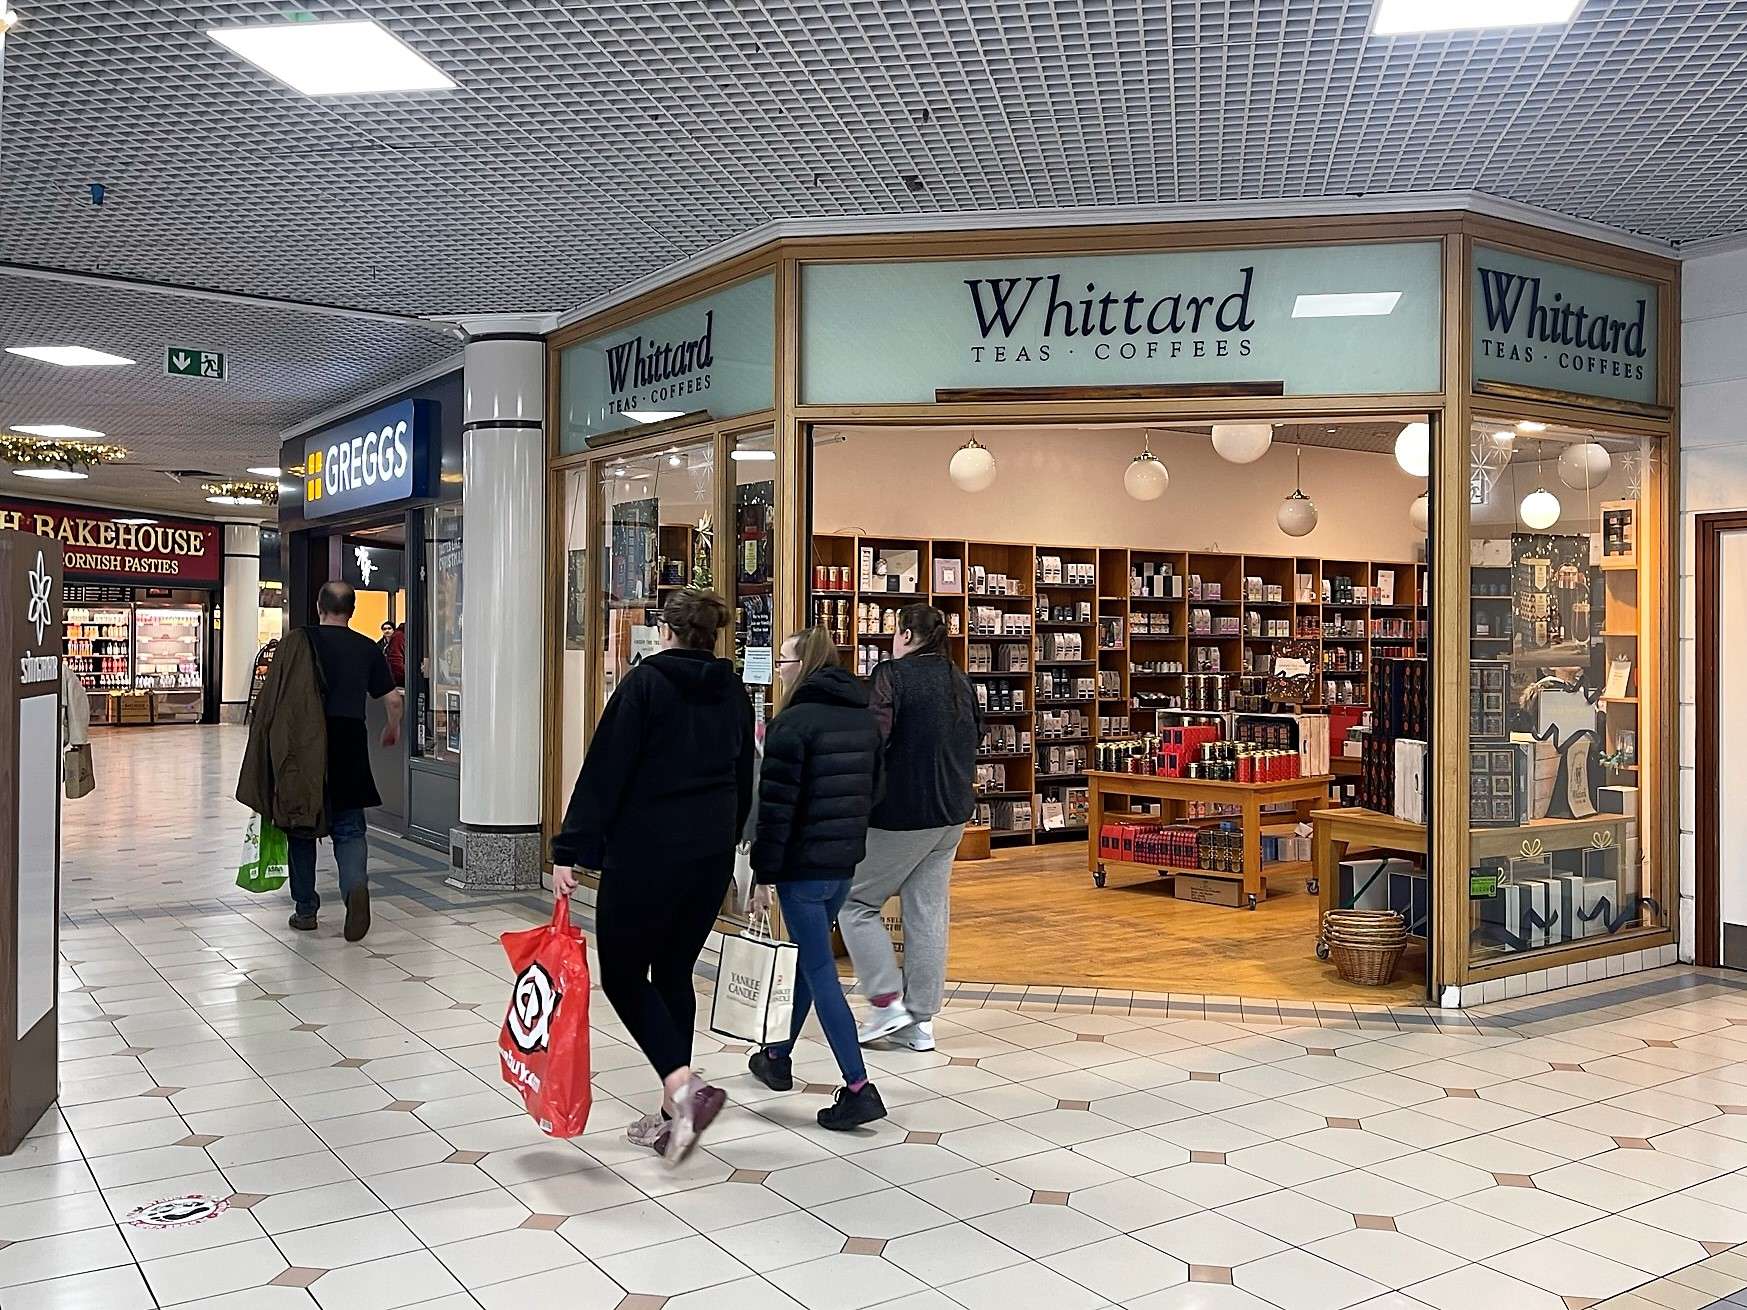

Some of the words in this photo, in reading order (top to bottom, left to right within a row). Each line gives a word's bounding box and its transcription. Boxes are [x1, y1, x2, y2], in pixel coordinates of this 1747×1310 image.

[963, 266, 1255, 338] Whittard
[1477, 267, 1647, 358] Whittard
[606, 310, 714, 395] Whittard
[971, 345, 1051, 363] TEAS
[1094, 339, 1252, 360] COFFEES
[1482, 339, 1533, 363] TEAS
[1559, 352, 1644, 381] COFFEES
[608, 395, 637, 415] TEAS
[651, 374, 711, 403] COFFEES
[325, 420, 408, 496] GREGGS
[34, 514, 206, 556] BAKEHOUSE
[62, 552, 121, 571] ORNISH
[124, 558, 179, 575] PASTIES
[728, 982, 760, 1002] CANDLE
[731, 972, 761, 991] YANKEE
